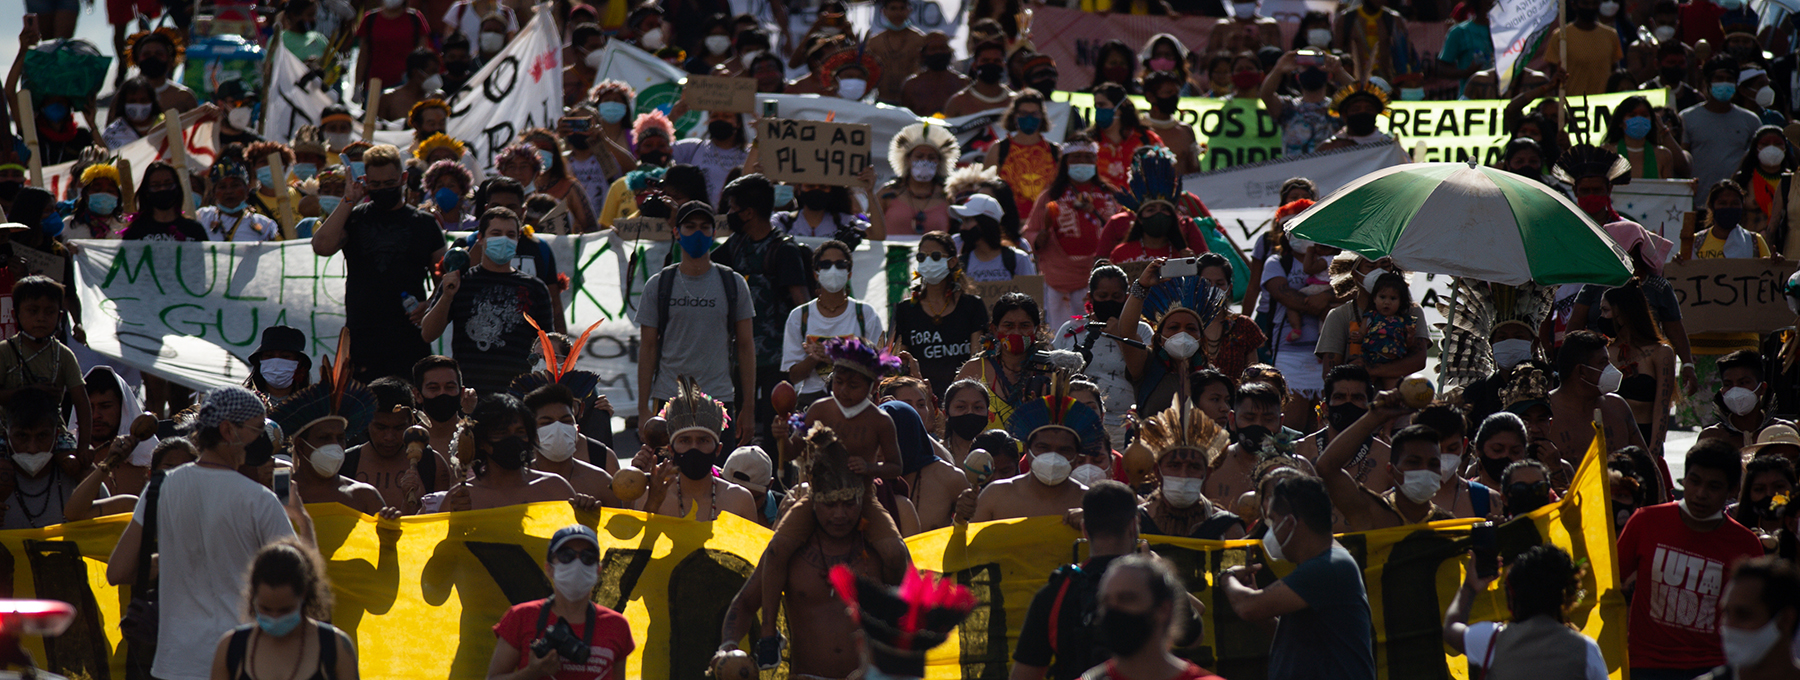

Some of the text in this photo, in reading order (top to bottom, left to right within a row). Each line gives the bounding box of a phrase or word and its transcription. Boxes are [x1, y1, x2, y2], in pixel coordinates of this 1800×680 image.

[768, 120, 866, 146] NÃO AO
[776, 146, 806, 173] PL
[669, 296, 716, 307] adidas
[910, 329, 943, 346] FORA
[1651, 546, 1724, 597] LUTA
[1649, 580, 1719, 631] VIDA
